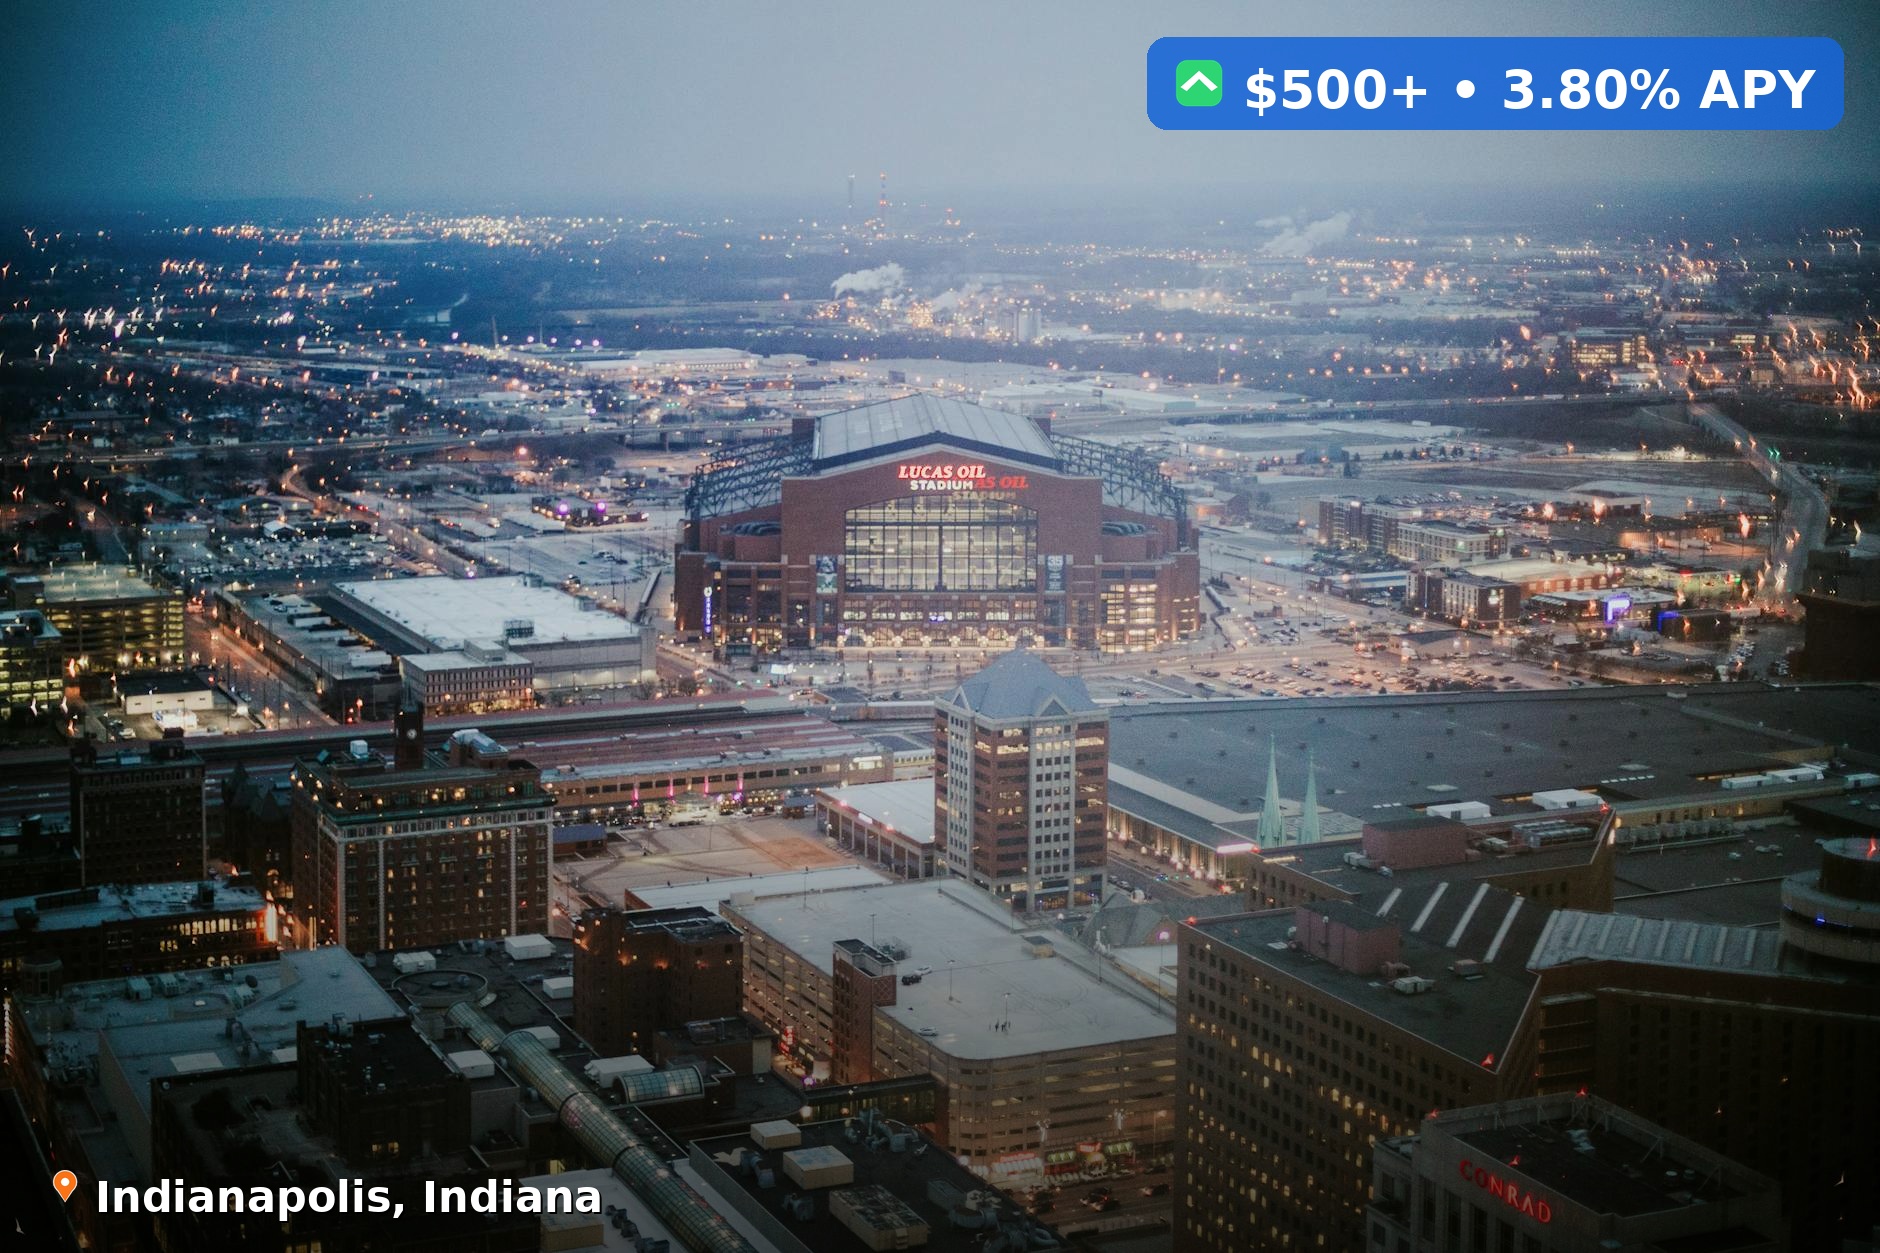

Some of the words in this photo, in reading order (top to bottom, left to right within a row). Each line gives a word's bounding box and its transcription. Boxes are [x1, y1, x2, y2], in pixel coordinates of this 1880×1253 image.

[898, 465, 953, 480] LUCAS
[956, 465, 986, 479] OIL
[910, 479, 974, 491] STADIUM
[1459, 1159, 1552, 1223] CONRAD
